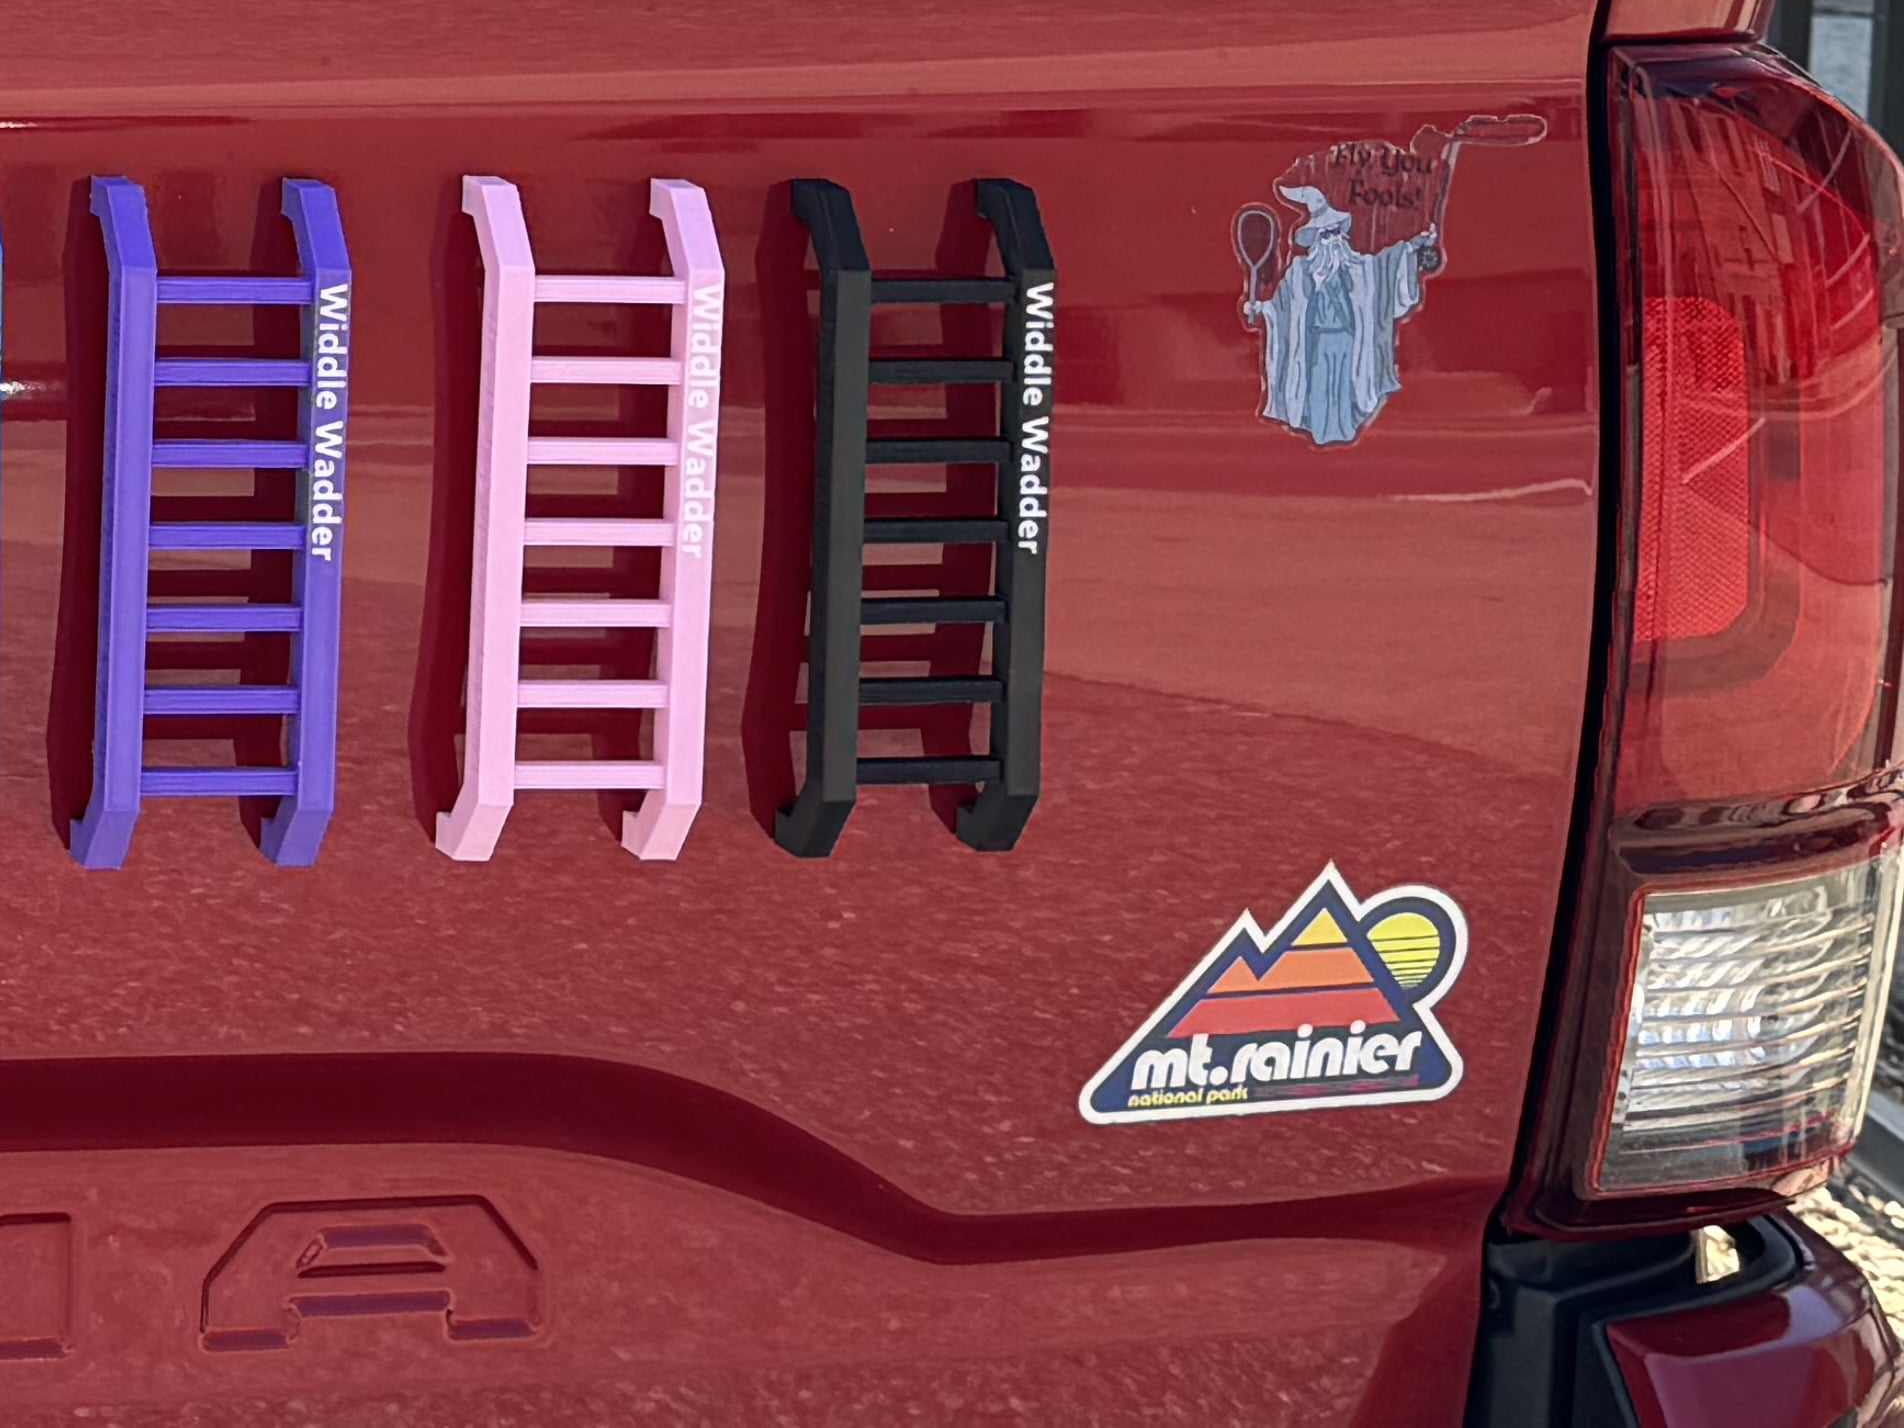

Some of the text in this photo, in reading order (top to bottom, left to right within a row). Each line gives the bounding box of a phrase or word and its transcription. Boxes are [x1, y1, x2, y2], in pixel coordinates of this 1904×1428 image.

[1380, 145, 1433, 177] You
[311, 283, 350, 562] Widdle Wadder
[682, 282, 722, 559] Widdle Wadder
[1017, 281, 1055, 555] Widdle Wadder
[1127, 1083, 1248, 1108] national park
